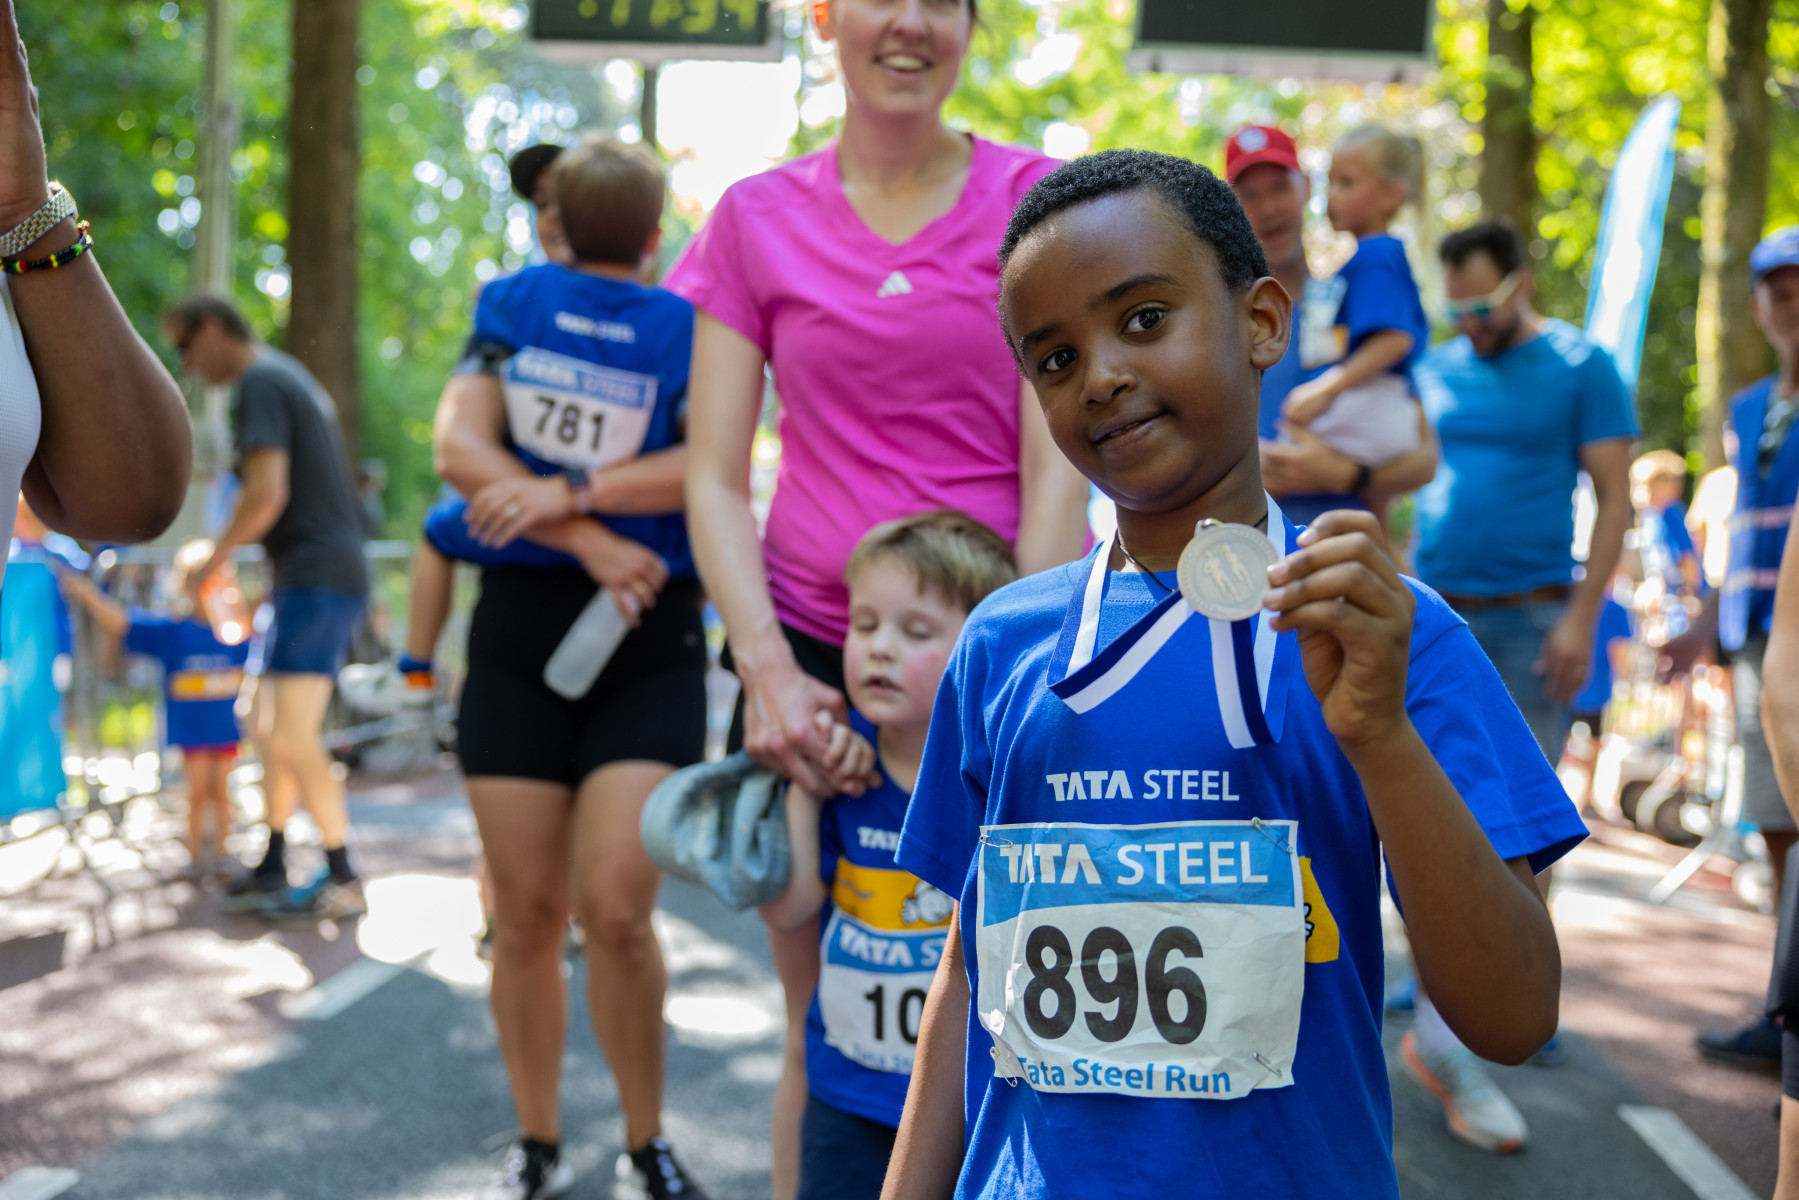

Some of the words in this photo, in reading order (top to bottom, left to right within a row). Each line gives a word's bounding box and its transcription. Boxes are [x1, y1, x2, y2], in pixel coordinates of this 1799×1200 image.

[535, 395, 605, 452] 781
[1046, 770, 1133, 801] TATA
[1143, 769, 1240, 801] STEEL
[857, 826, 901, 851] TAT
[1000, 843, 1102, 885] TATA
[1117, 840, 1269, 886] STEEL
[839, 922, 915, 968] TATA
[1023, 924, 1208, 1045] 896
[1072, 1058, 1155, 1091] Steel
[1165, 1064, 1231, 1094] Run
